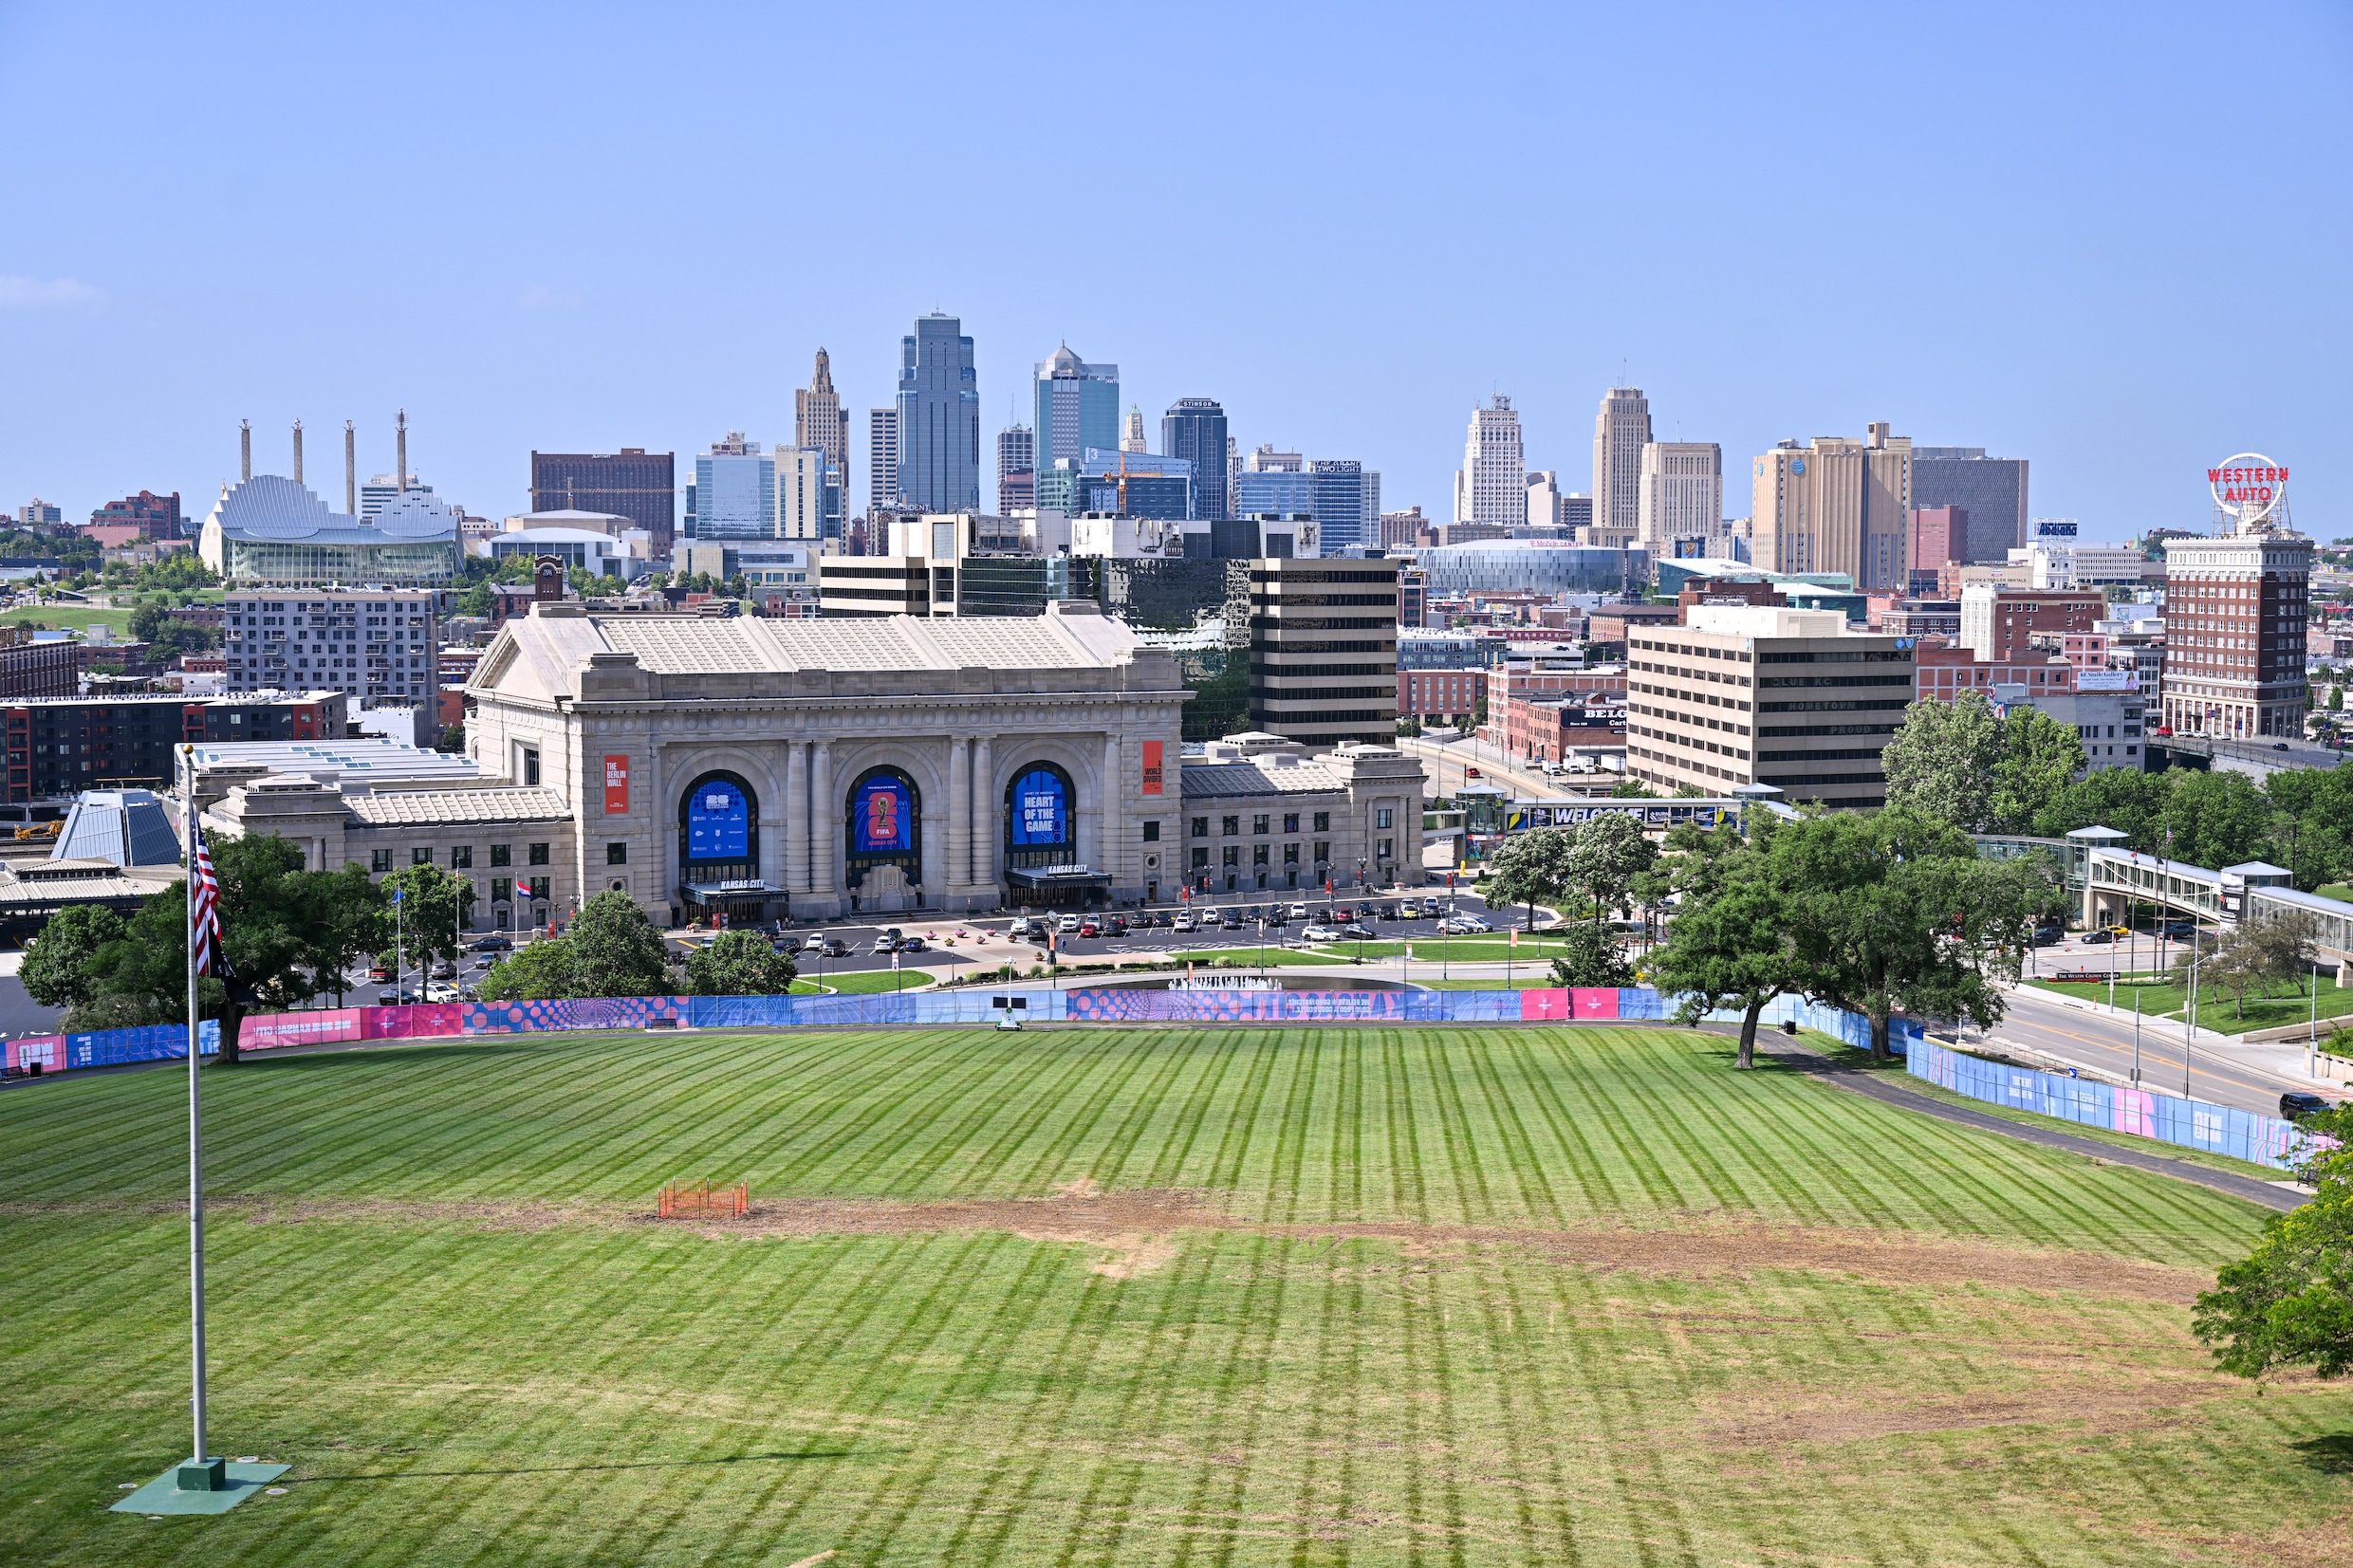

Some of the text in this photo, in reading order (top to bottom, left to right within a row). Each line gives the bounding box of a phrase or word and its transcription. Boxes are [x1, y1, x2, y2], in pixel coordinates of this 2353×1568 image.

[1090, 448, 1099, 460] 3
[2207, 468, 2289, 483] WESTERN
[2225, 487, 2271, 501] AUTO
[1772, 677, 1831, 687] BLUE KC
[1788, 701, 1855, 711] HOMETOWN
[1830, 725, 1871, 735] PROUD
[606, 762, 618, 770] THE
[606, 779, 622, 787] WALL
[1025, 796, 1054, 808] HEART
[1025, 808, 1054, 821] OF THE
[1026, 821, 1053, 832] GAME
[1047, 864, 1088, 874] KANSAS CITY
[721, 878, 765, 890] KANSAS CITY
